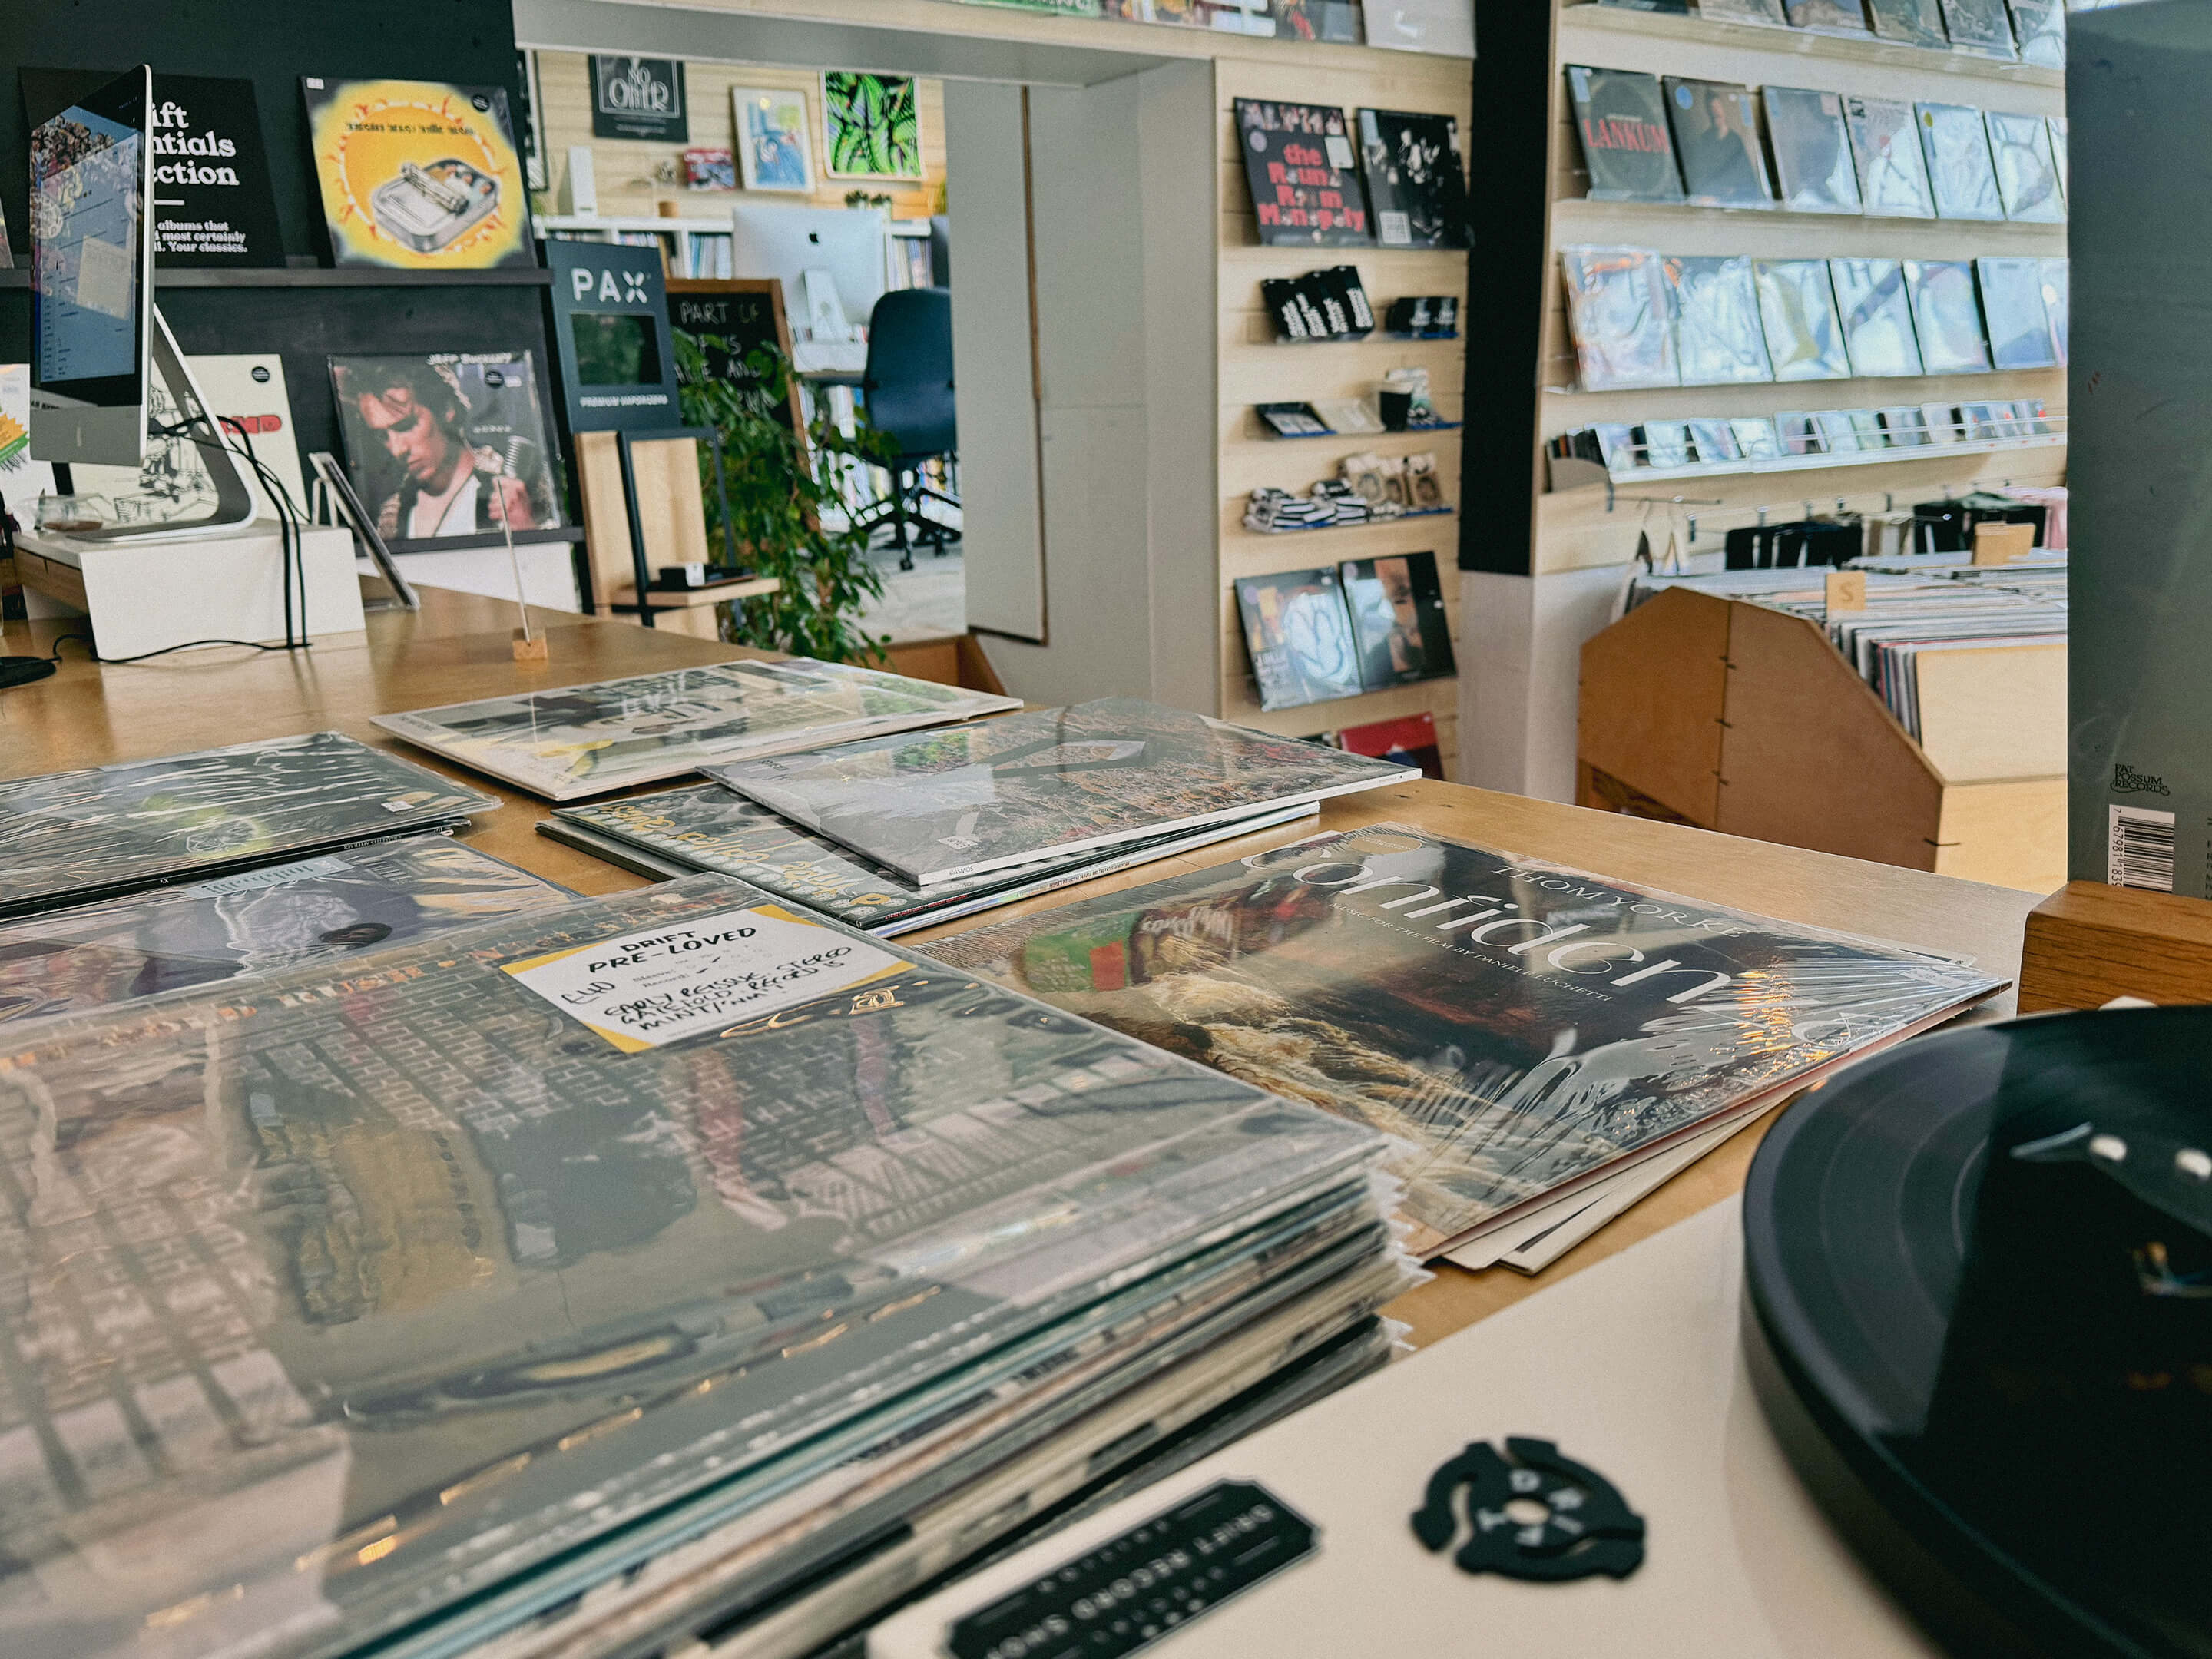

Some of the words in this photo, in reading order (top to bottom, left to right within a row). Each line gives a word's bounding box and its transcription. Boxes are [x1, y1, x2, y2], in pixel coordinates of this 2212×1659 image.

[152, 101, 189, 128] ift
[153, 130, 237, 157] ntials
[1583, 118, 1671, 154] LANKUM
[156, 159, 240, 186] ction
[157, 220, 203, 230] albums
[204, 220, 229, 231] that
[161, 232, 191, 241] most
[193, 231, 246, 243] certainly
[167, 241, 197, 252] Your
[571, 267, 647, 303] PAX
[680, 300, 729, 325] PART
[1840, 581, 1854, 602] S
[2110, 780, 2171, 796] RECORDS
[2114, 771, 2163, 786] POSSUM
[1492, 865, 1606, 901] THOM
[1607, 896, 1755, 939] YORKE
[588, 927, 757, 974] PRE-LOVED
[620, 930, 696, 952] DRIFT
[1329, 902, 1366, 919] MUSIC
[1368, 916, 1395, 929] FOR
[1395, 926, 1422, 939] THE
[1422, 935, 1454, 950] FILM
[1454, 946, 1475, 956] BY
[1474, 954, 1536, 977] DANIELE
[1535, 974, 1613, 1002] LUCHETTI
[1194, 1502, 1275, 1555] DRIFT
[1071, 1548, 1192, 1621] RECORD
